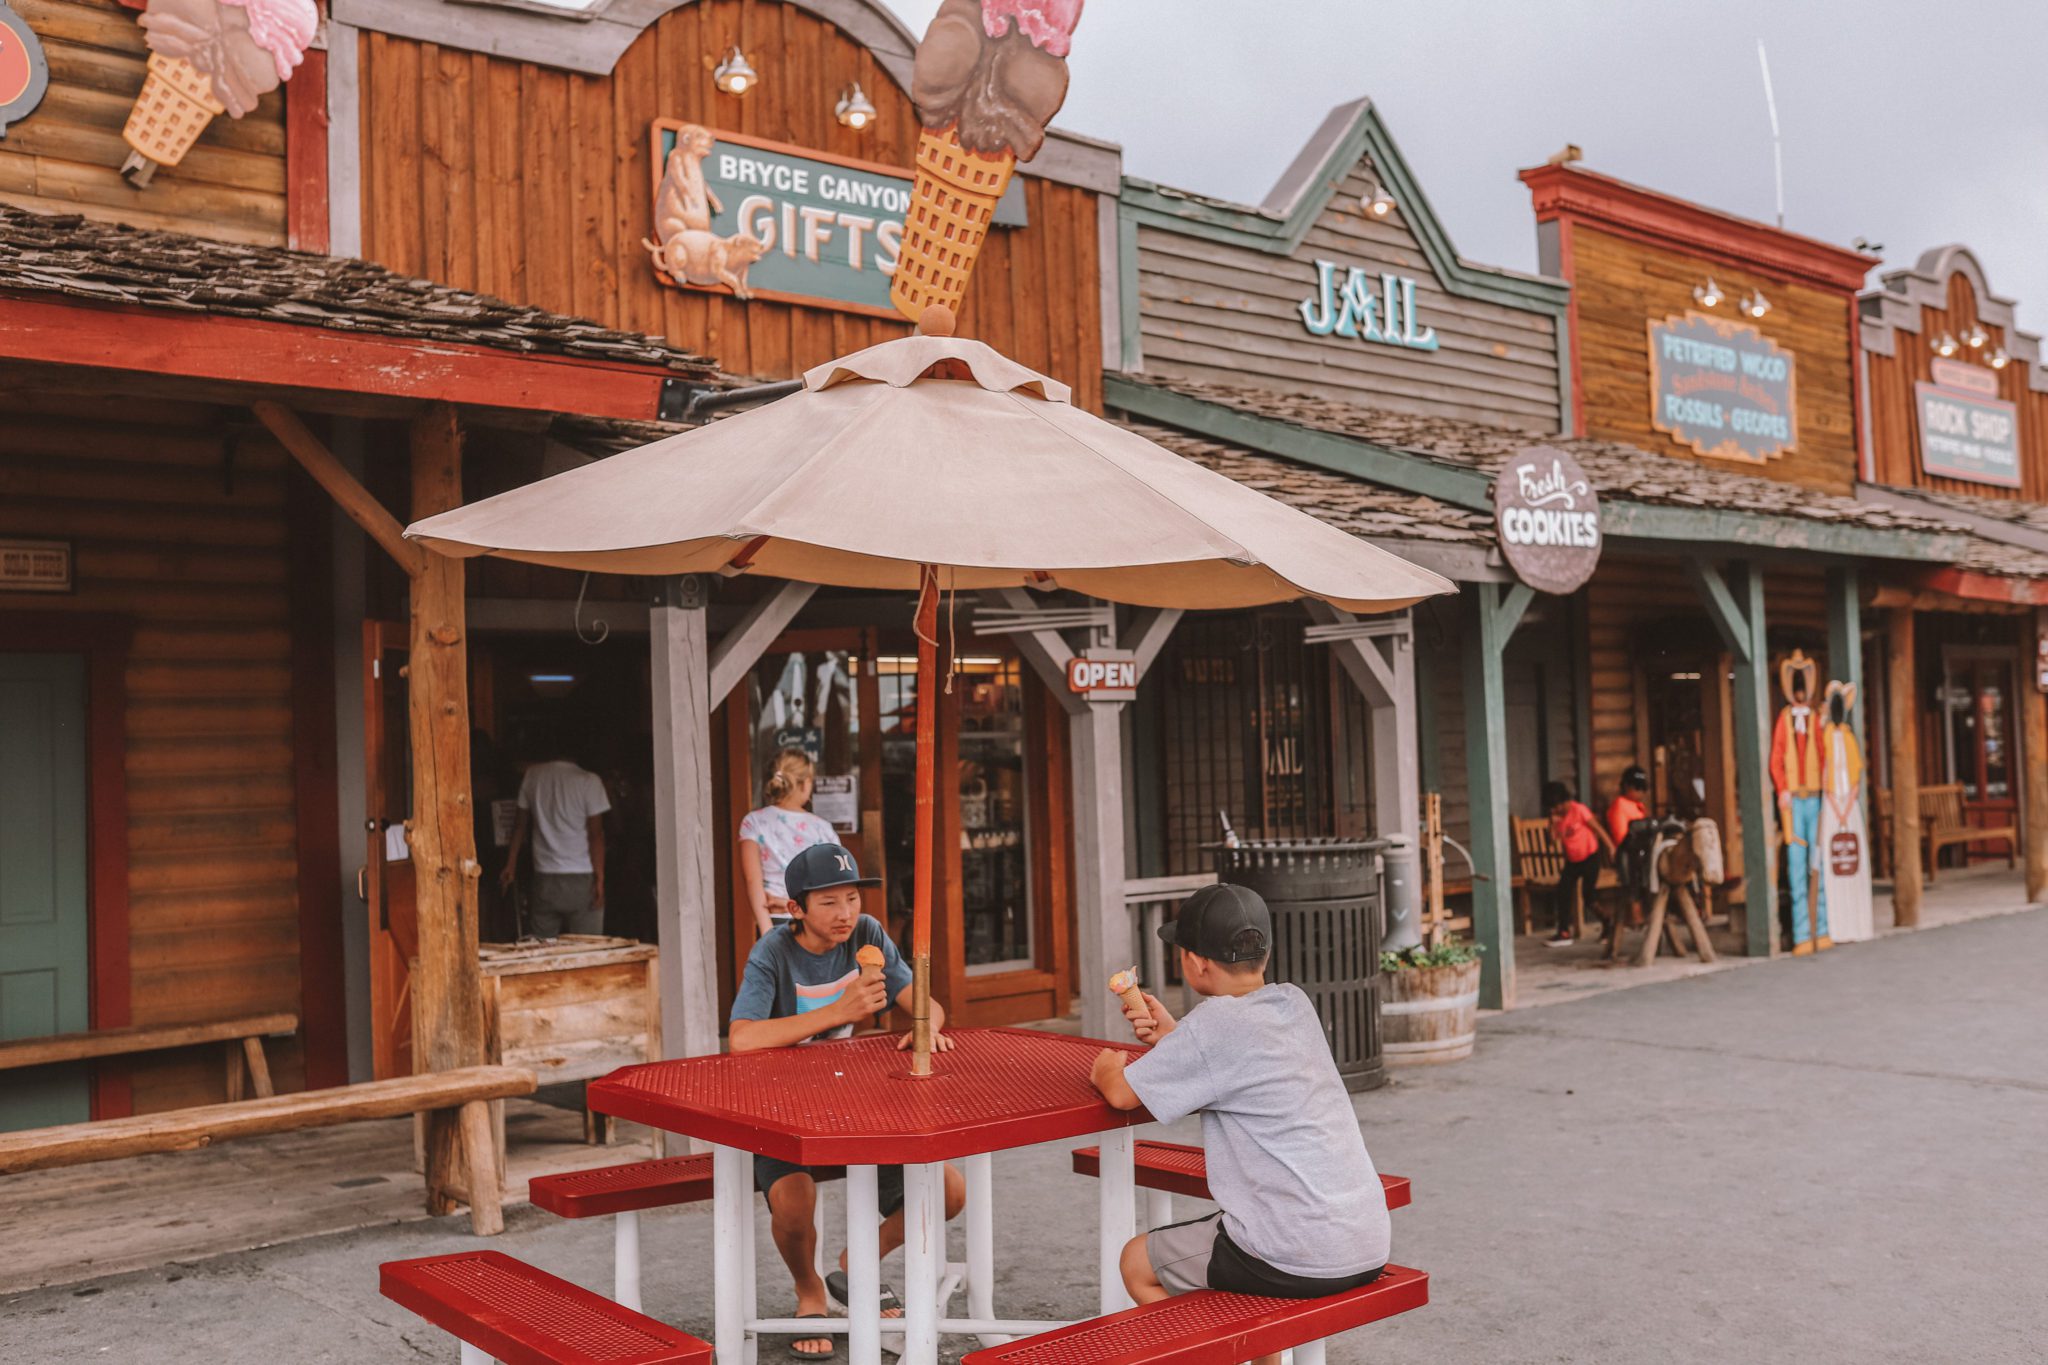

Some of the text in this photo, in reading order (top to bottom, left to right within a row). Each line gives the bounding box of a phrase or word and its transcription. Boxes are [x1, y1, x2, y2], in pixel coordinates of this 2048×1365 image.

[720, 155, 912, 213] BRYCE CANYON
[737, 195, 904, 276] GIFTS
[1300, 259, 1440, 351] JAIL
[1740, 350, 1787, 381] WOOD
[1664, 394, 1788, 439] FOSSILS GEODES
[1925, 400, 2010, 444] ROCK SHOP
[1516, 459, 1572, 500] Fresh
[1502, 507, 1598, 547] COOKIES
[1073, 662, 1135, 687] OPEN
